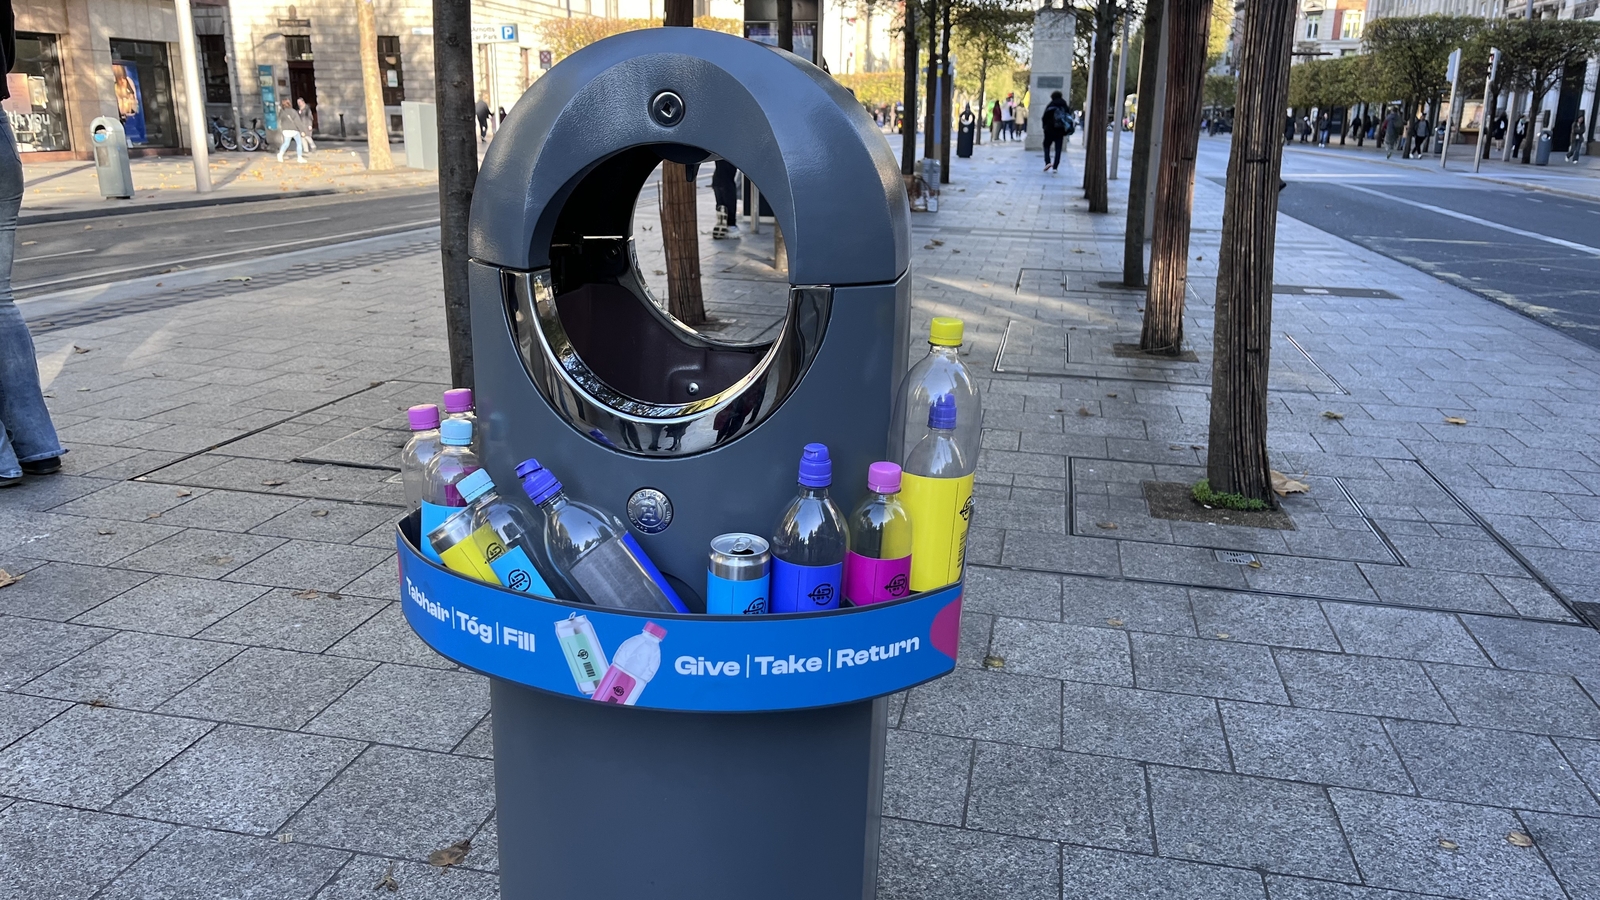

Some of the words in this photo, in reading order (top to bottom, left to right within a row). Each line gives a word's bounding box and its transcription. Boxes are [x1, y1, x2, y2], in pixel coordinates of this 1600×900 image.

[504, 26, 512, 39] P
[26, 113, 50, 132] you
[405, 576, 450, 622] Tabhair
[456, 611, 493, 644] Tóg
[503, 626, 536, 653] Fill
[674, 655, 741, 676] Give
[754, 655, 823, 676] Take
[836, 636, 920, 668] Return
